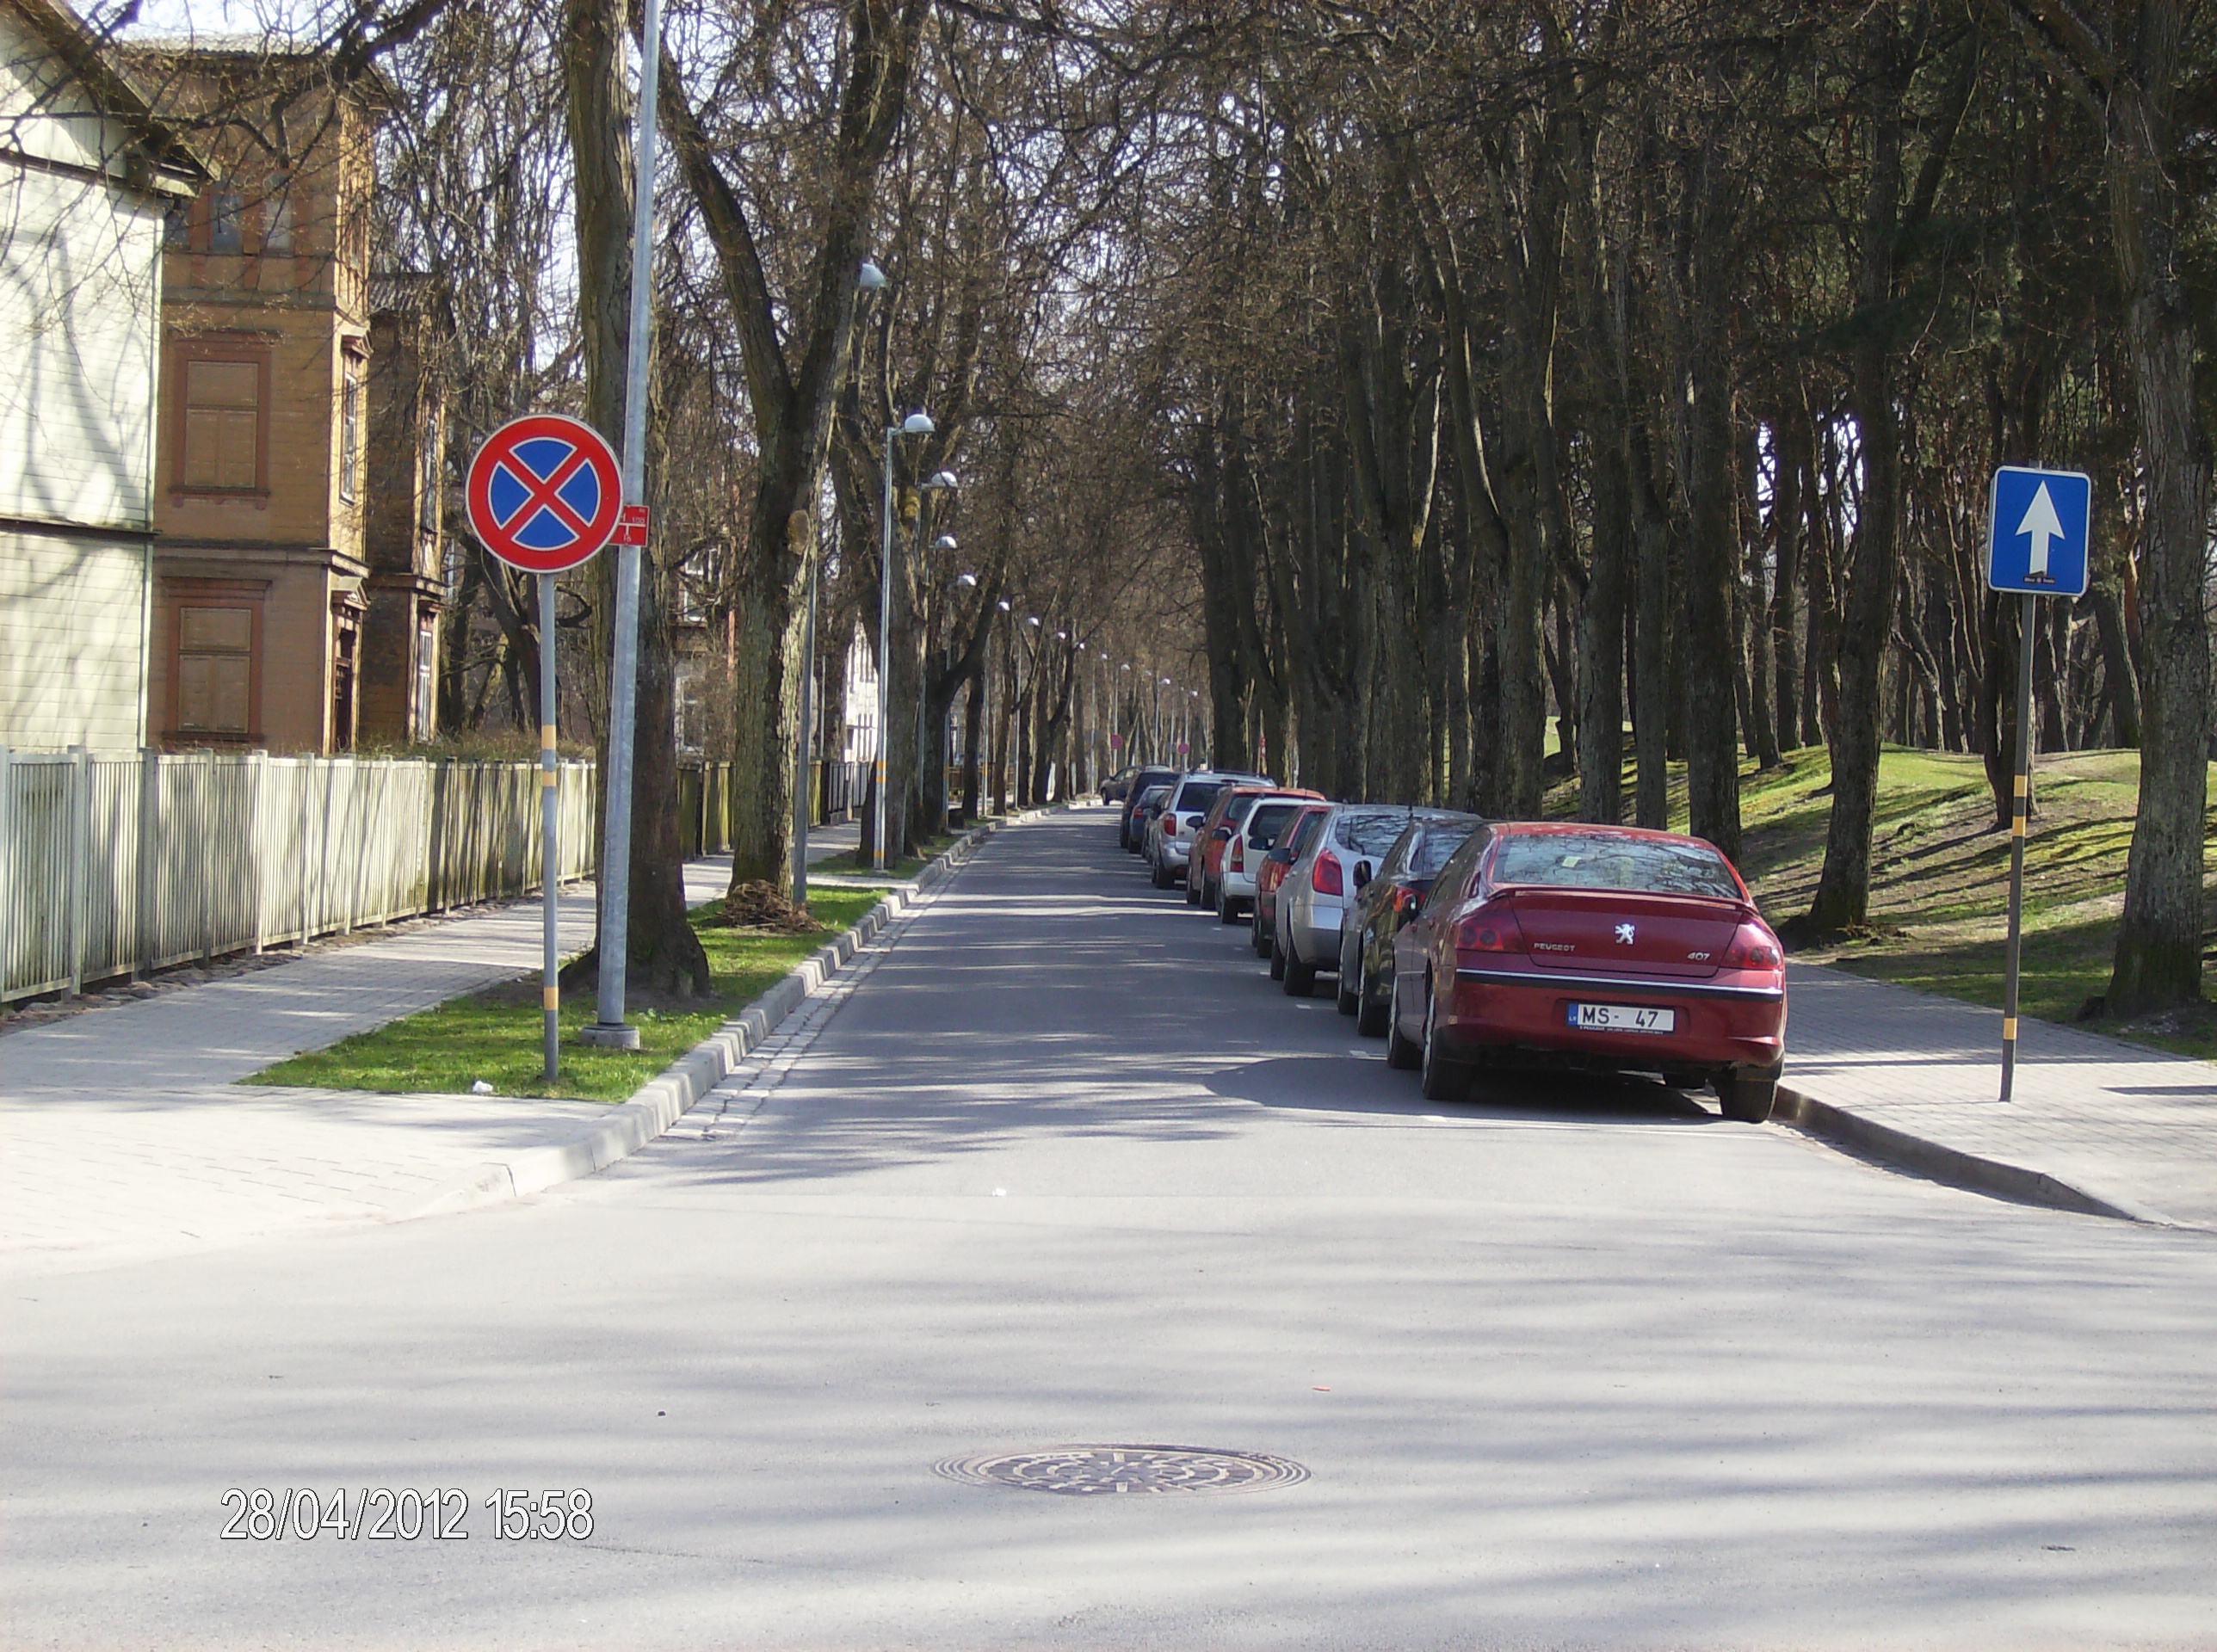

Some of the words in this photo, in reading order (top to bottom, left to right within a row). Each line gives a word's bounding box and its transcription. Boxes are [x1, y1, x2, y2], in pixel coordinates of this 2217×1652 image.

[1534, 942, 1576, 952] PEUGEOT
[1687, 952, 1711, 961] 407
[1635, 1010, 1659, 1028] 47
